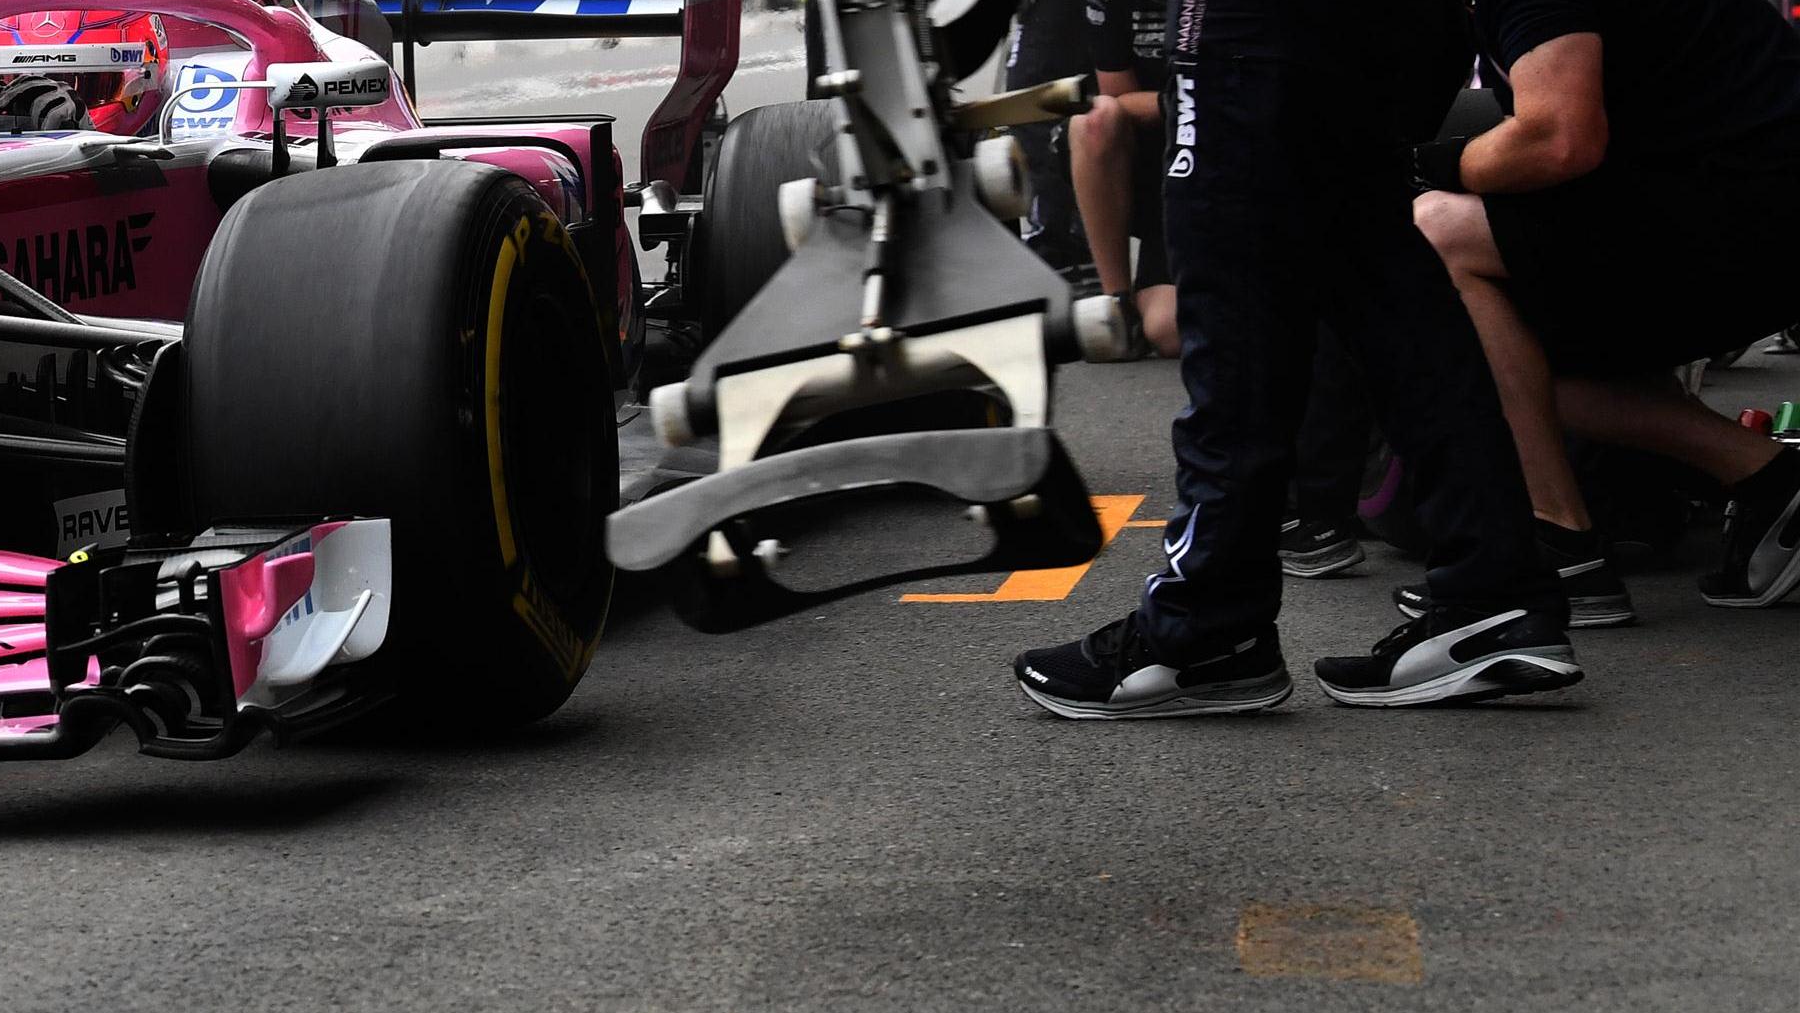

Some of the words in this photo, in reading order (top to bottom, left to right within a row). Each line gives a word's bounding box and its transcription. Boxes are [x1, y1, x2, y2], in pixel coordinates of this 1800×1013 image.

[30, 53, 77, 63] AMG
[121, 49, 144, 63] BWT
[324, 78, 388, 96] PEMEX
[1176, 74, 1197, 147] BWT
